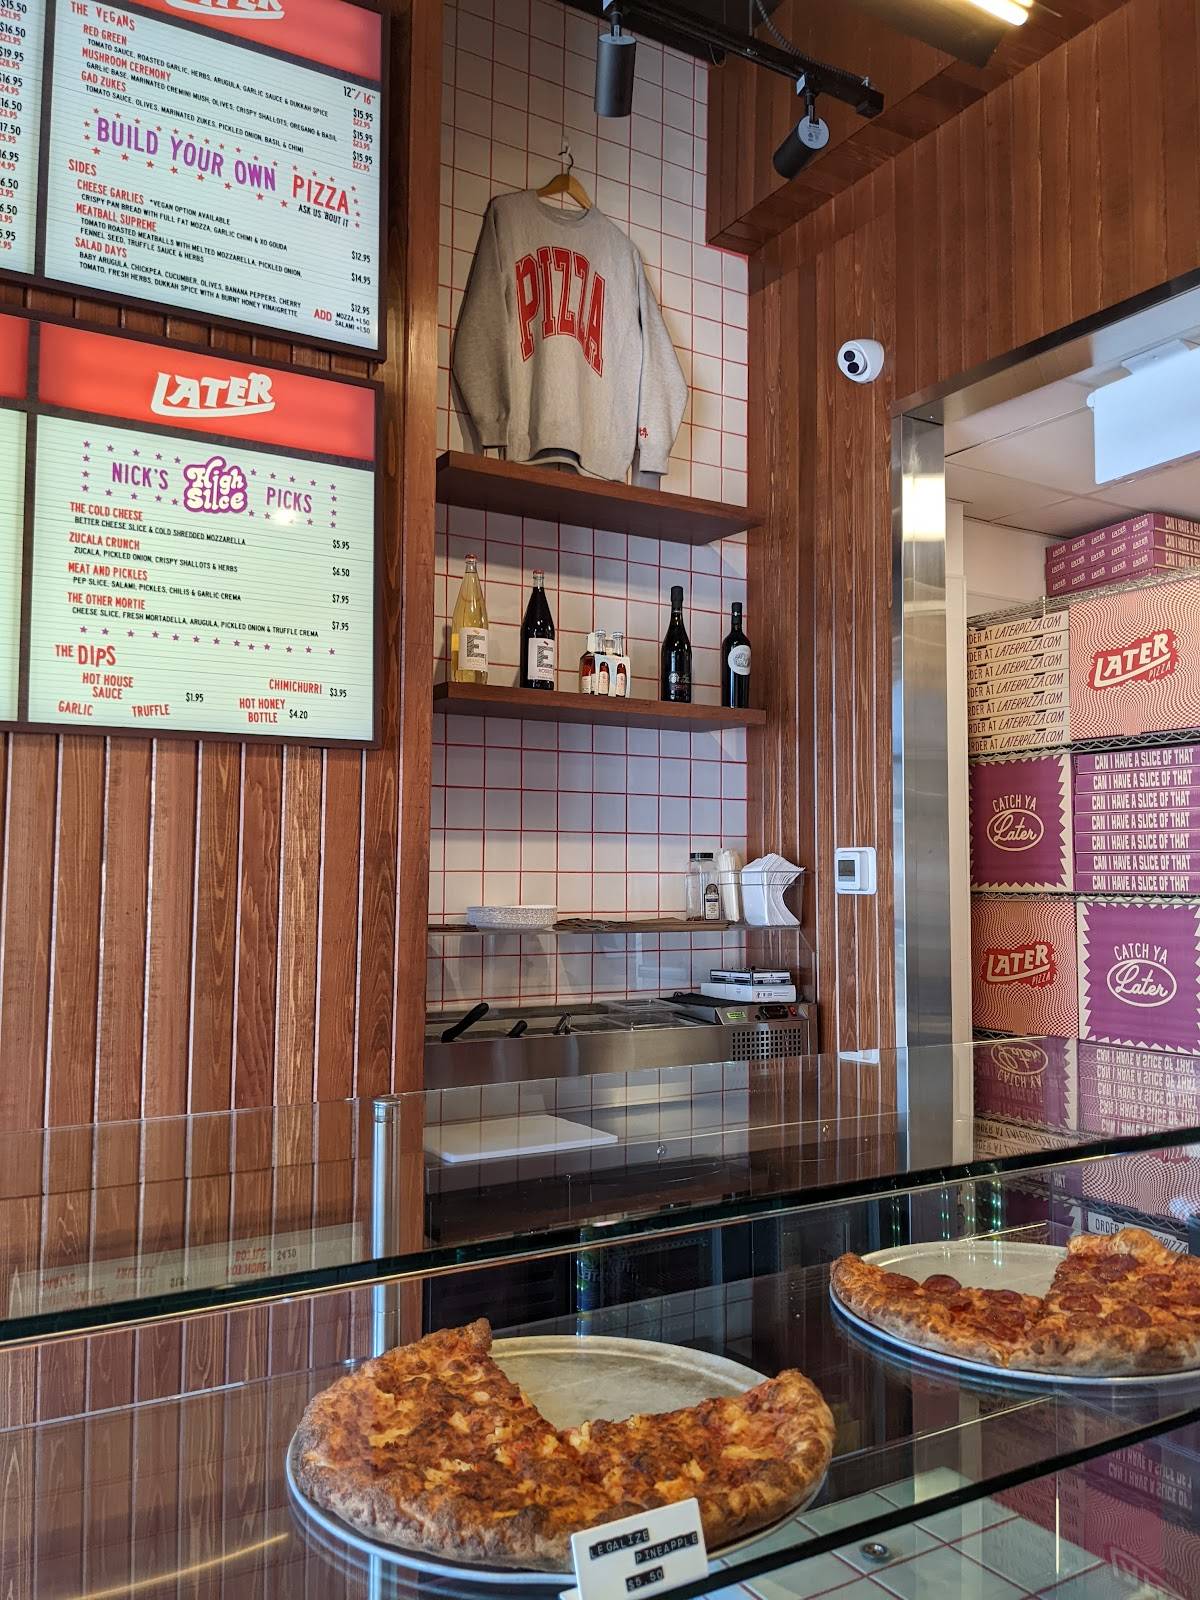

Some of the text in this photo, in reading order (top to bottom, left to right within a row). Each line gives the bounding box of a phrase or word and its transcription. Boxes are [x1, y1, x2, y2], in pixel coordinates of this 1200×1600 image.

[72, 1, 135, 31] THE VEGANS
[83, 24, 126, 45] RED GREEN
[82, 48, 170, 82] MUSHROOM CEREMONY
[81, 71, 126, 92] GAD ZUKES
[353, 108, 373, 122] $15.95
[353, 130, 373, 143] $15.95
[98, 116, 349, 215] BUILD YOUR OWN PIZZA
[353, 151, 372, 164] $15.95
[68, 159, 96, 176] SIDES
[77, 179, 143, 204] CHEESE GARLIES
[76, 203, 156, 231] MEATBALL SUPREME
[298, 204, 311, 213] ASK
[313, 208, 321, 219] US
[342, 216, 348, 228] IT
[75, 237, 126, 258] SALAD DAYS
[81, 218, 105, 230] TOMATO
[107, 224, 136, 237] ROASTED
[138, 231, 174, 246] MEATBALLS
[175, 240, 190, 250] WITH
[192, 244, 215, 256] MELTED
[258, 259, 282, 272] PICKLED
[352, 250, 370, 263] $12.95
[352, 273, 370, 285] $14.95
[314, 309, 332, 321] ADD
[336, 312, 354, 322] MOZZA
[351, 304, 370, 315] $12.95
[516, 246, 605, 377] PIZZA
[335, 320, 354, 330] SALAMI
[150, 372, 275, 417] LATER
[112, 462, 168, 490] NICK'S
[187, 460, 244, 495] High
[267, 486, 312, 513] PICKS
[70, 502, 142, 521] THE COLD CHEESE
[74, 517, 99, 526] BETTER
[101, 520, 126, 530] CHEESE
[128, 524, 146, 532] SLICE
[154, 527, 171, 535] COLD
[172, 530, 204, 540] SHREDDED
[206, 534, 245, 545] MOZZARELLA
[69, 532, 139, 550] ZUCALA CRUNCH
[332, 539, 350, 550] $5.95
[103, 550, 130, 560] PICKLED
[155, 556, 177, 565] CRISPY
[179, 559, 210, 569] SHALLOTS
[218, 564, 237, 572] HERBS
[68, 562, 147, 580] MEAT AND PICKLES
[332, 567, 350, 577] $6.50
[68, 592, 145, 609] THE OTHER MORTIE
[169, 587, 189, 595] CHILIS
[197, 590, 219, 599] GARLIC
[220, 592, 241, 601] CREMA
[332, 594, 349, 604] $7.95
[72, 607, 97, 616] CHEESE
[122, 612, 143, 620] FRESH
[220, 621, 246, 630] PICKLED
[247, 624, 265, 632] ONION
[272, 626, 298, 635] TRUFFLE
[300, 629, 318, 637] CREMA
[332, 621, 349, 631] $7.95
[56, 645, 115, 667] THE DIPS
[1093, 633, 1171, 688] LATER
[82, 672, 133, 688] HOT HOUSE
[1148, 662, 1171, 680] PIZZA
[93, 687, 122, 699] SAUCE
[269, 679, 322, 694] CHIMICHURRI
[330, 688, 347, 698] $3.95
[186, 692, 203, 703] $1.95
[240, 698, 285, 709] HOT HONEY
[59, 701, 93, 716] GARLIC
[132, 704, 170, 717] TRUFFLE
[248, 712, 278, 723] BOTTLE
[289, 709, 307, 719] $4.20
[989, 720, 996, 731] AT
[999, 711, 1064, 730] LATERPIZZA.COM
[990, 738, 998, 749] AT
[1000, 730, 1064, 748] LATERPIZZA.COM
[1095, 748, 1193, 770] CAN I HAVE A SLICE OF THAT
[992, 795, 1037, 812] CATCH YA
[994, 811, 1036, 841] Later
[1114, 943, 1167, 963] CATCH YA
[986, 945, 1050, 982] LATER
[1032, 973, 1050, 986] PIZZA
[1116, 964, 1169, 997] Later
[590, 1530, 649, 1558] LEGALIZE
[636, 1534, 698, 1562] PINEAPPLE
[628, 1569, 663, 1590] $5.50
